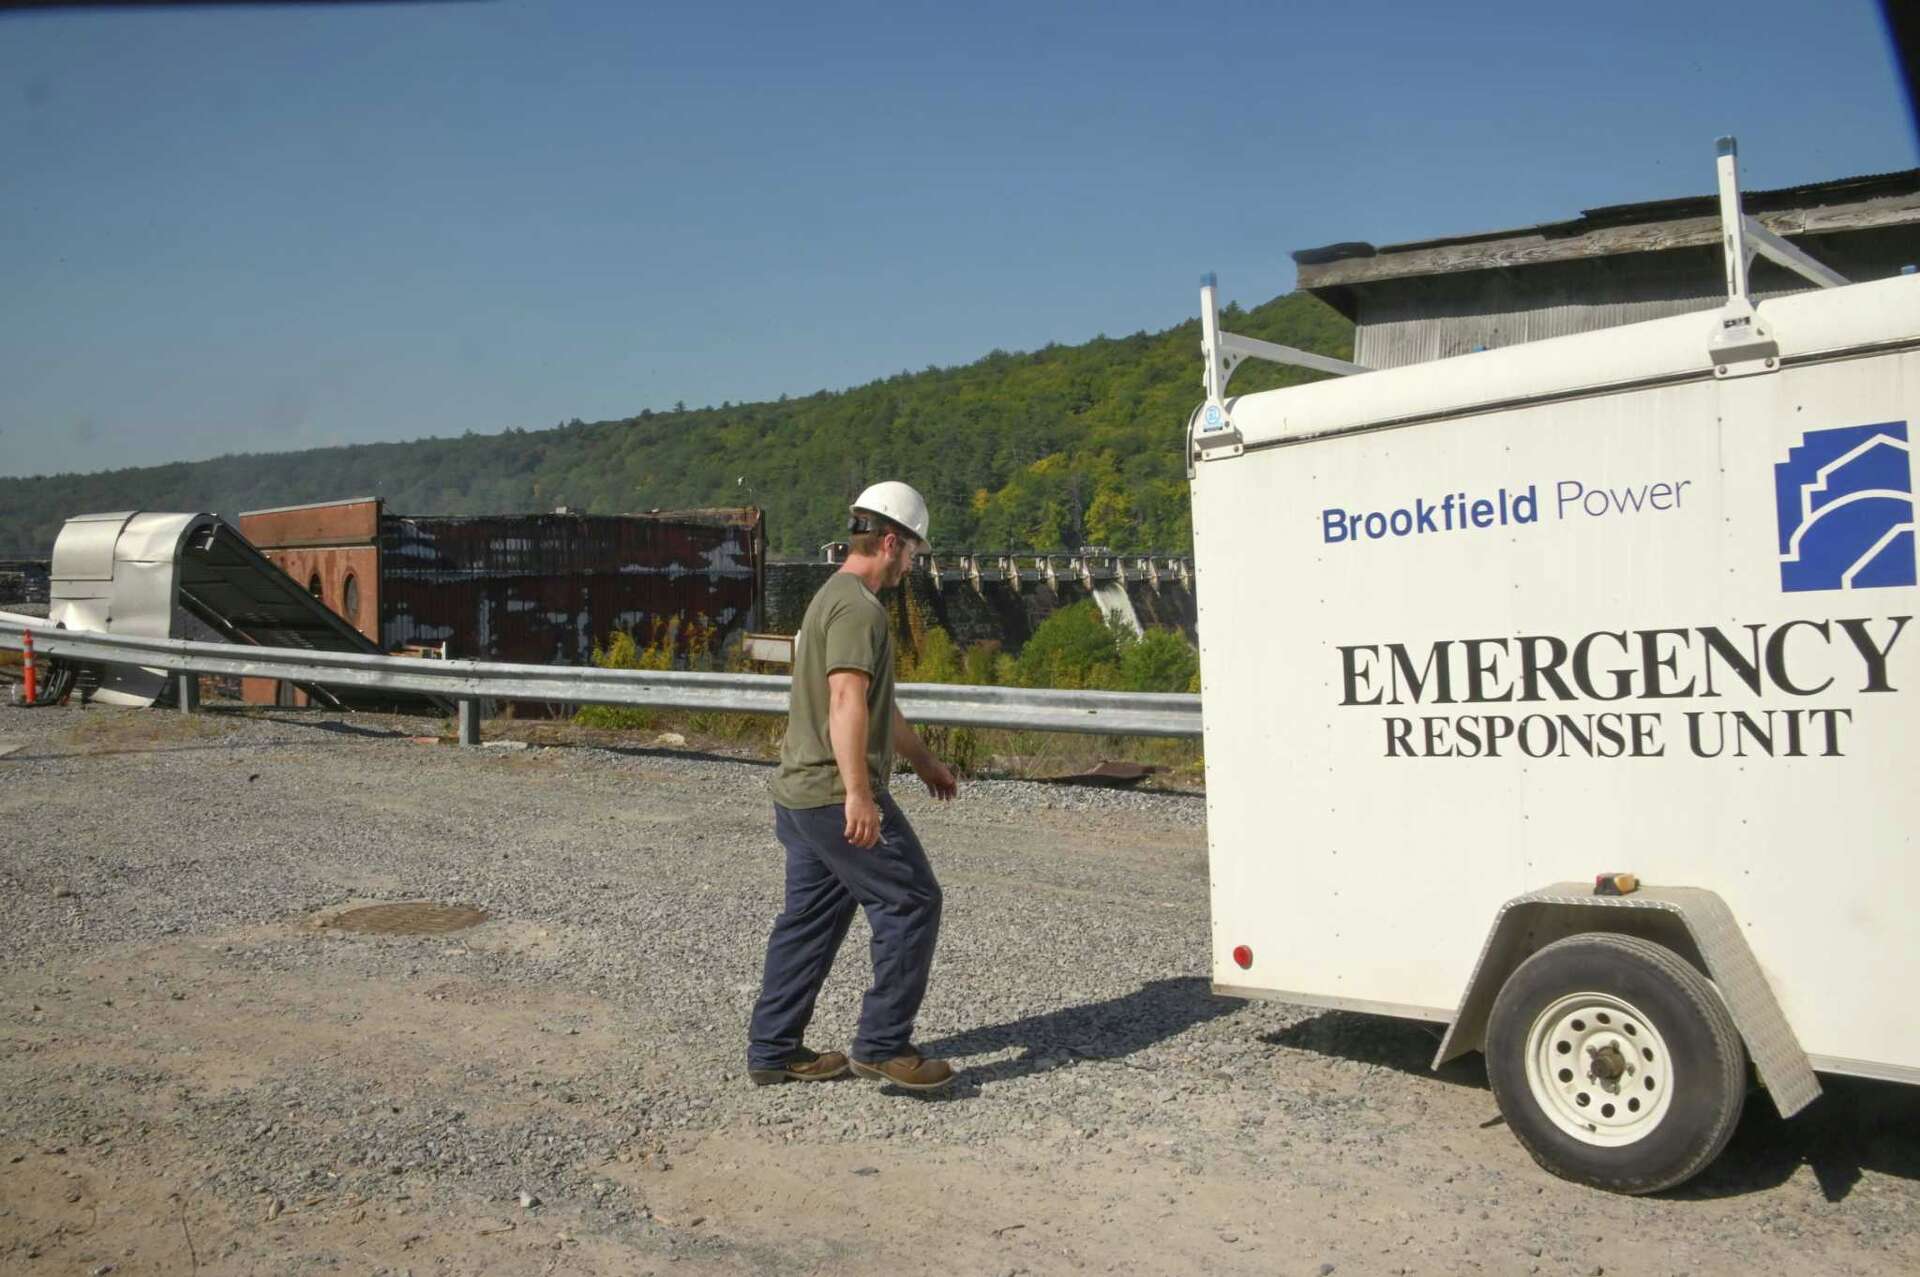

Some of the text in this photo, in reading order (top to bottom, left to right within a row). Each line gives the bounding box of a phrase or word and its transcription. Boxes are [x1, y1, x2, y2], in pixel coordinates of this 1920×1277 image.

[1322, 478, 1691, 543] Brookfield Power
[1336, 616, 1913, 706] EMERGENCY
[1383, 708, 1852, 758] RESPONSE UNIT
